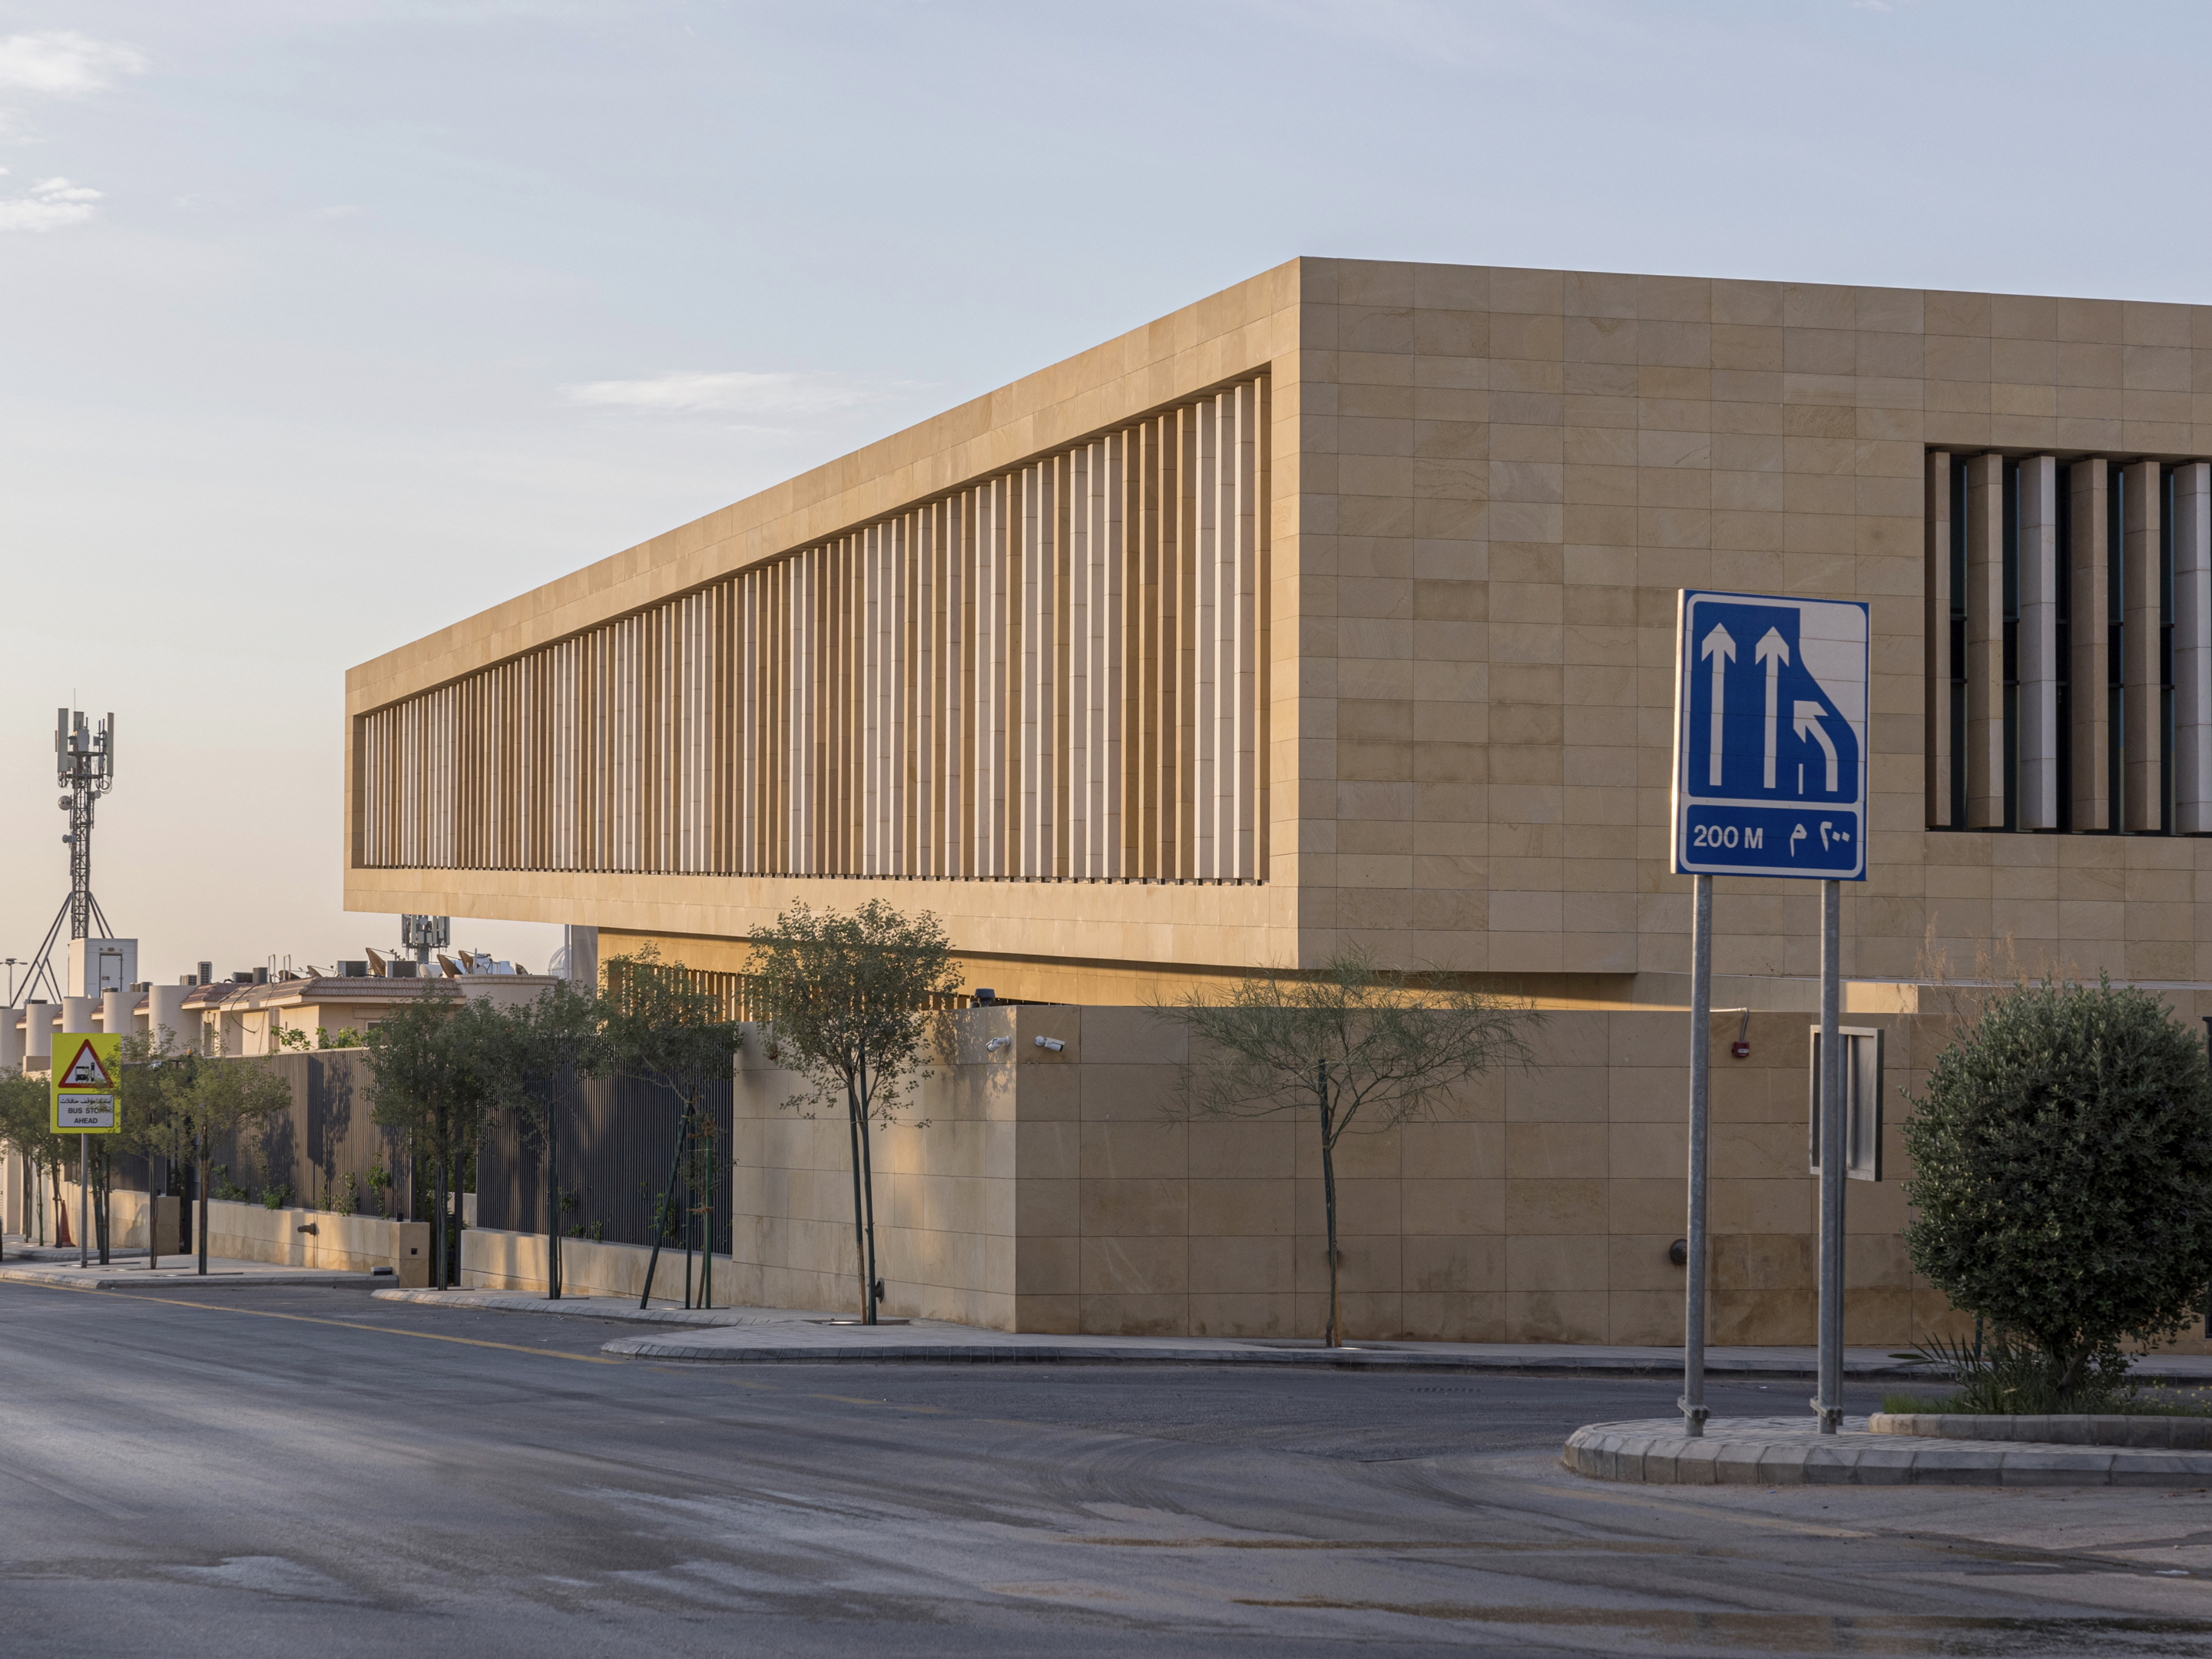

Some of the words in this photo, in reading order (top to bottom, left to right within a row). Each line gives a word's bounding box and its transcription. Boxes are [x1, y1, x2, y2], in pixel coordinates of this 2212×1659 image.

[1694, 824, 1739, 848] 200
[1744, 827, 1763, 849] M
[1790, 823, 1807, 857] م
[1820, 821, 1850, 852] ٢٠٠
